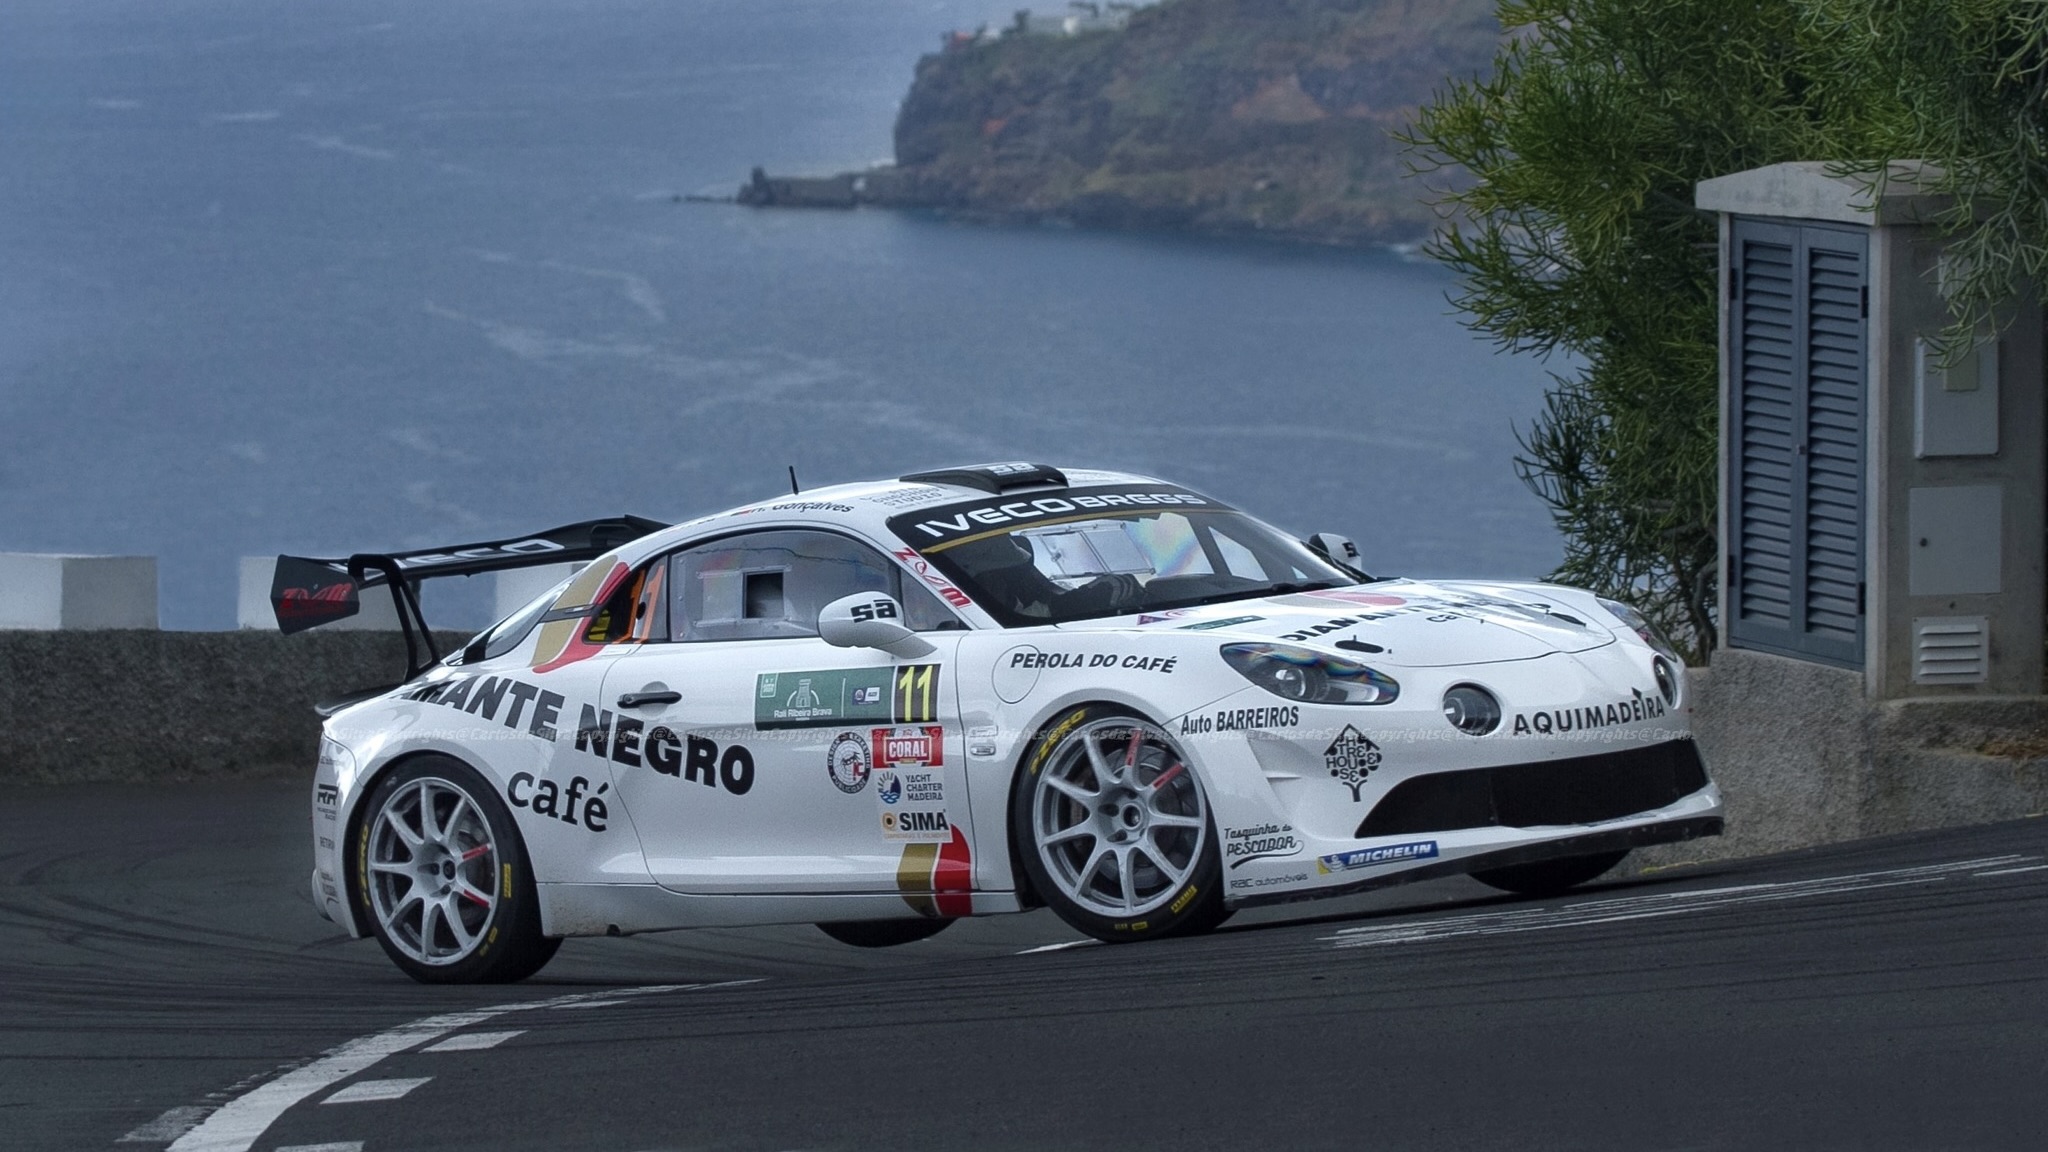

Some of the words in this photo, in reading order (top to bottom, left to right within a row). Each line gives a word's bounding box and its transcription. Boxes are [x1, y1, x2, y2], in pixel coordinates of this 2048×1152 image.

[914, 498, 1076, 538] IVECO
[1011, 653, 1083, 669] PEROLA
[1089, 654, 1117, 668] DO
[1121, 656, 1178, 674] CAFÉ
[900, 665, 933, 723] 11
[1181, 714, 1212, 736] Auto
[1216, 705, 1299, 732] BARREIROS
[1512, 694, 1666, 736] AQUIMADEIRA
[574, 702, 756, 796] NEGRO
[888, 740, 928, 758] CORAL
[905, 773, 932, 783] YACHT
[906, 782, 943, 792] CHARTER
[507, 771, 609, 833] café
[907, 791, 943, 801] MADEIRA
[899, 812, 949, 831] SIMA
[1224, 823, 1280, 841] Tasquinha
[1226, 835, 1298, 857] PESCADOR
[1348, 843, 1433, 865] MICHELIN
